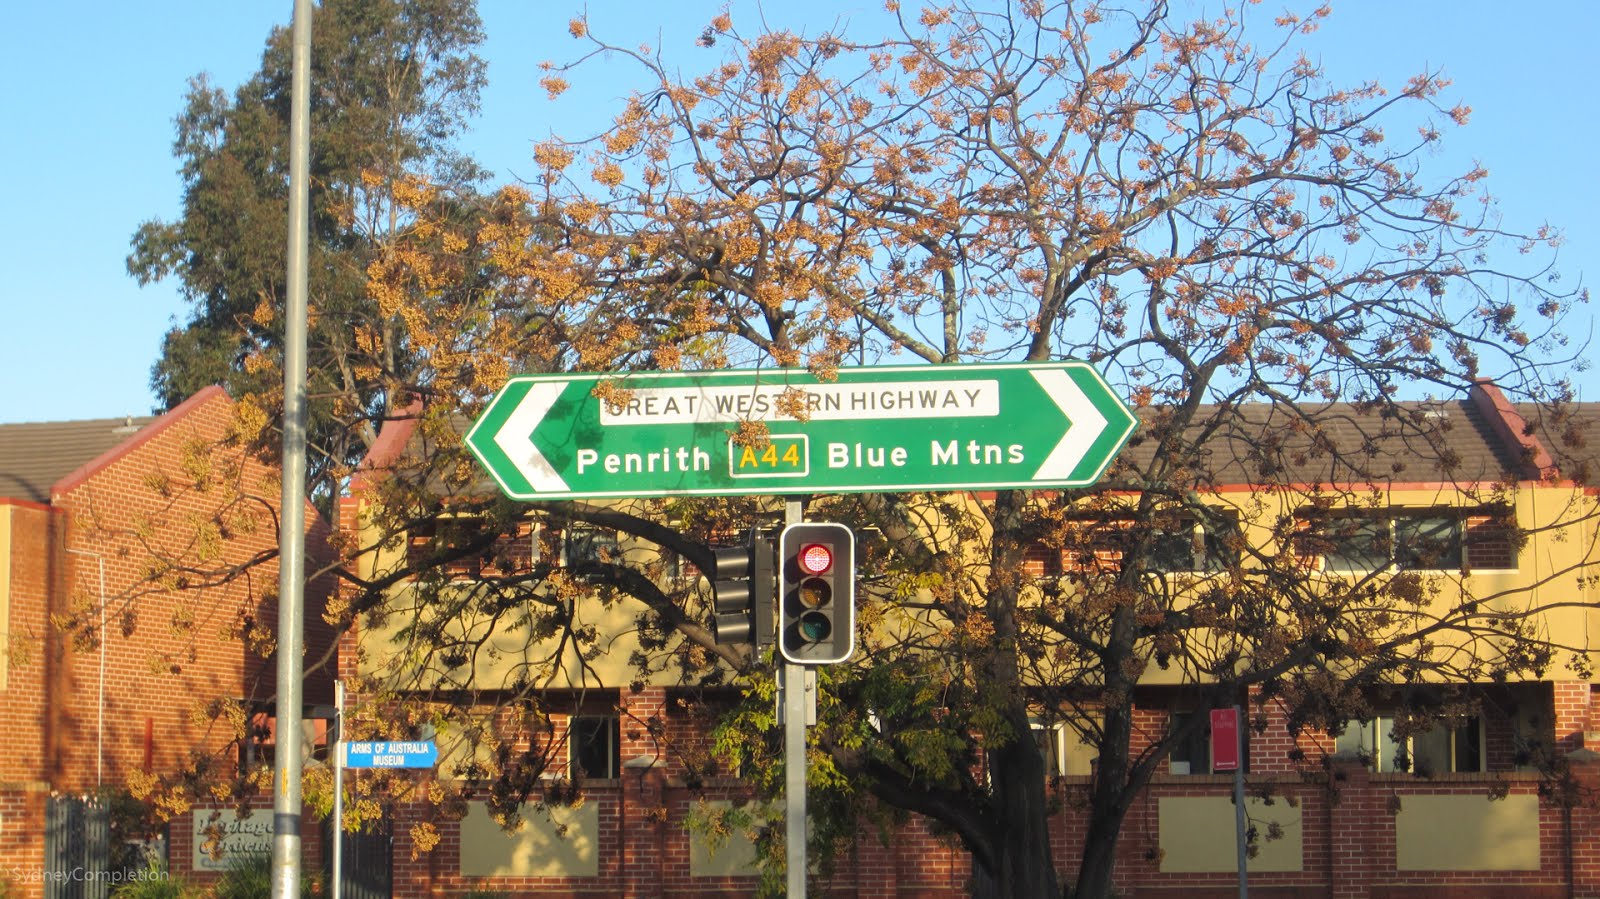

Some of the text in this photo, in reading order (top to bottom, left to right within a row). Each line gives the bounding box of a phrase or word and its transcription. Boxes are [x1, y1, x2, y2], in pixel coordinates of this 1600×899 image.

[851, 389, 981, 411] HIGHWAY
[576, 439, 1025, 476] Penrith A44 Blue Mtns
[350, 743, 429, 754] ARMS OF AUSTRALIA
[372, 755, 405, 766] MUSEUM
